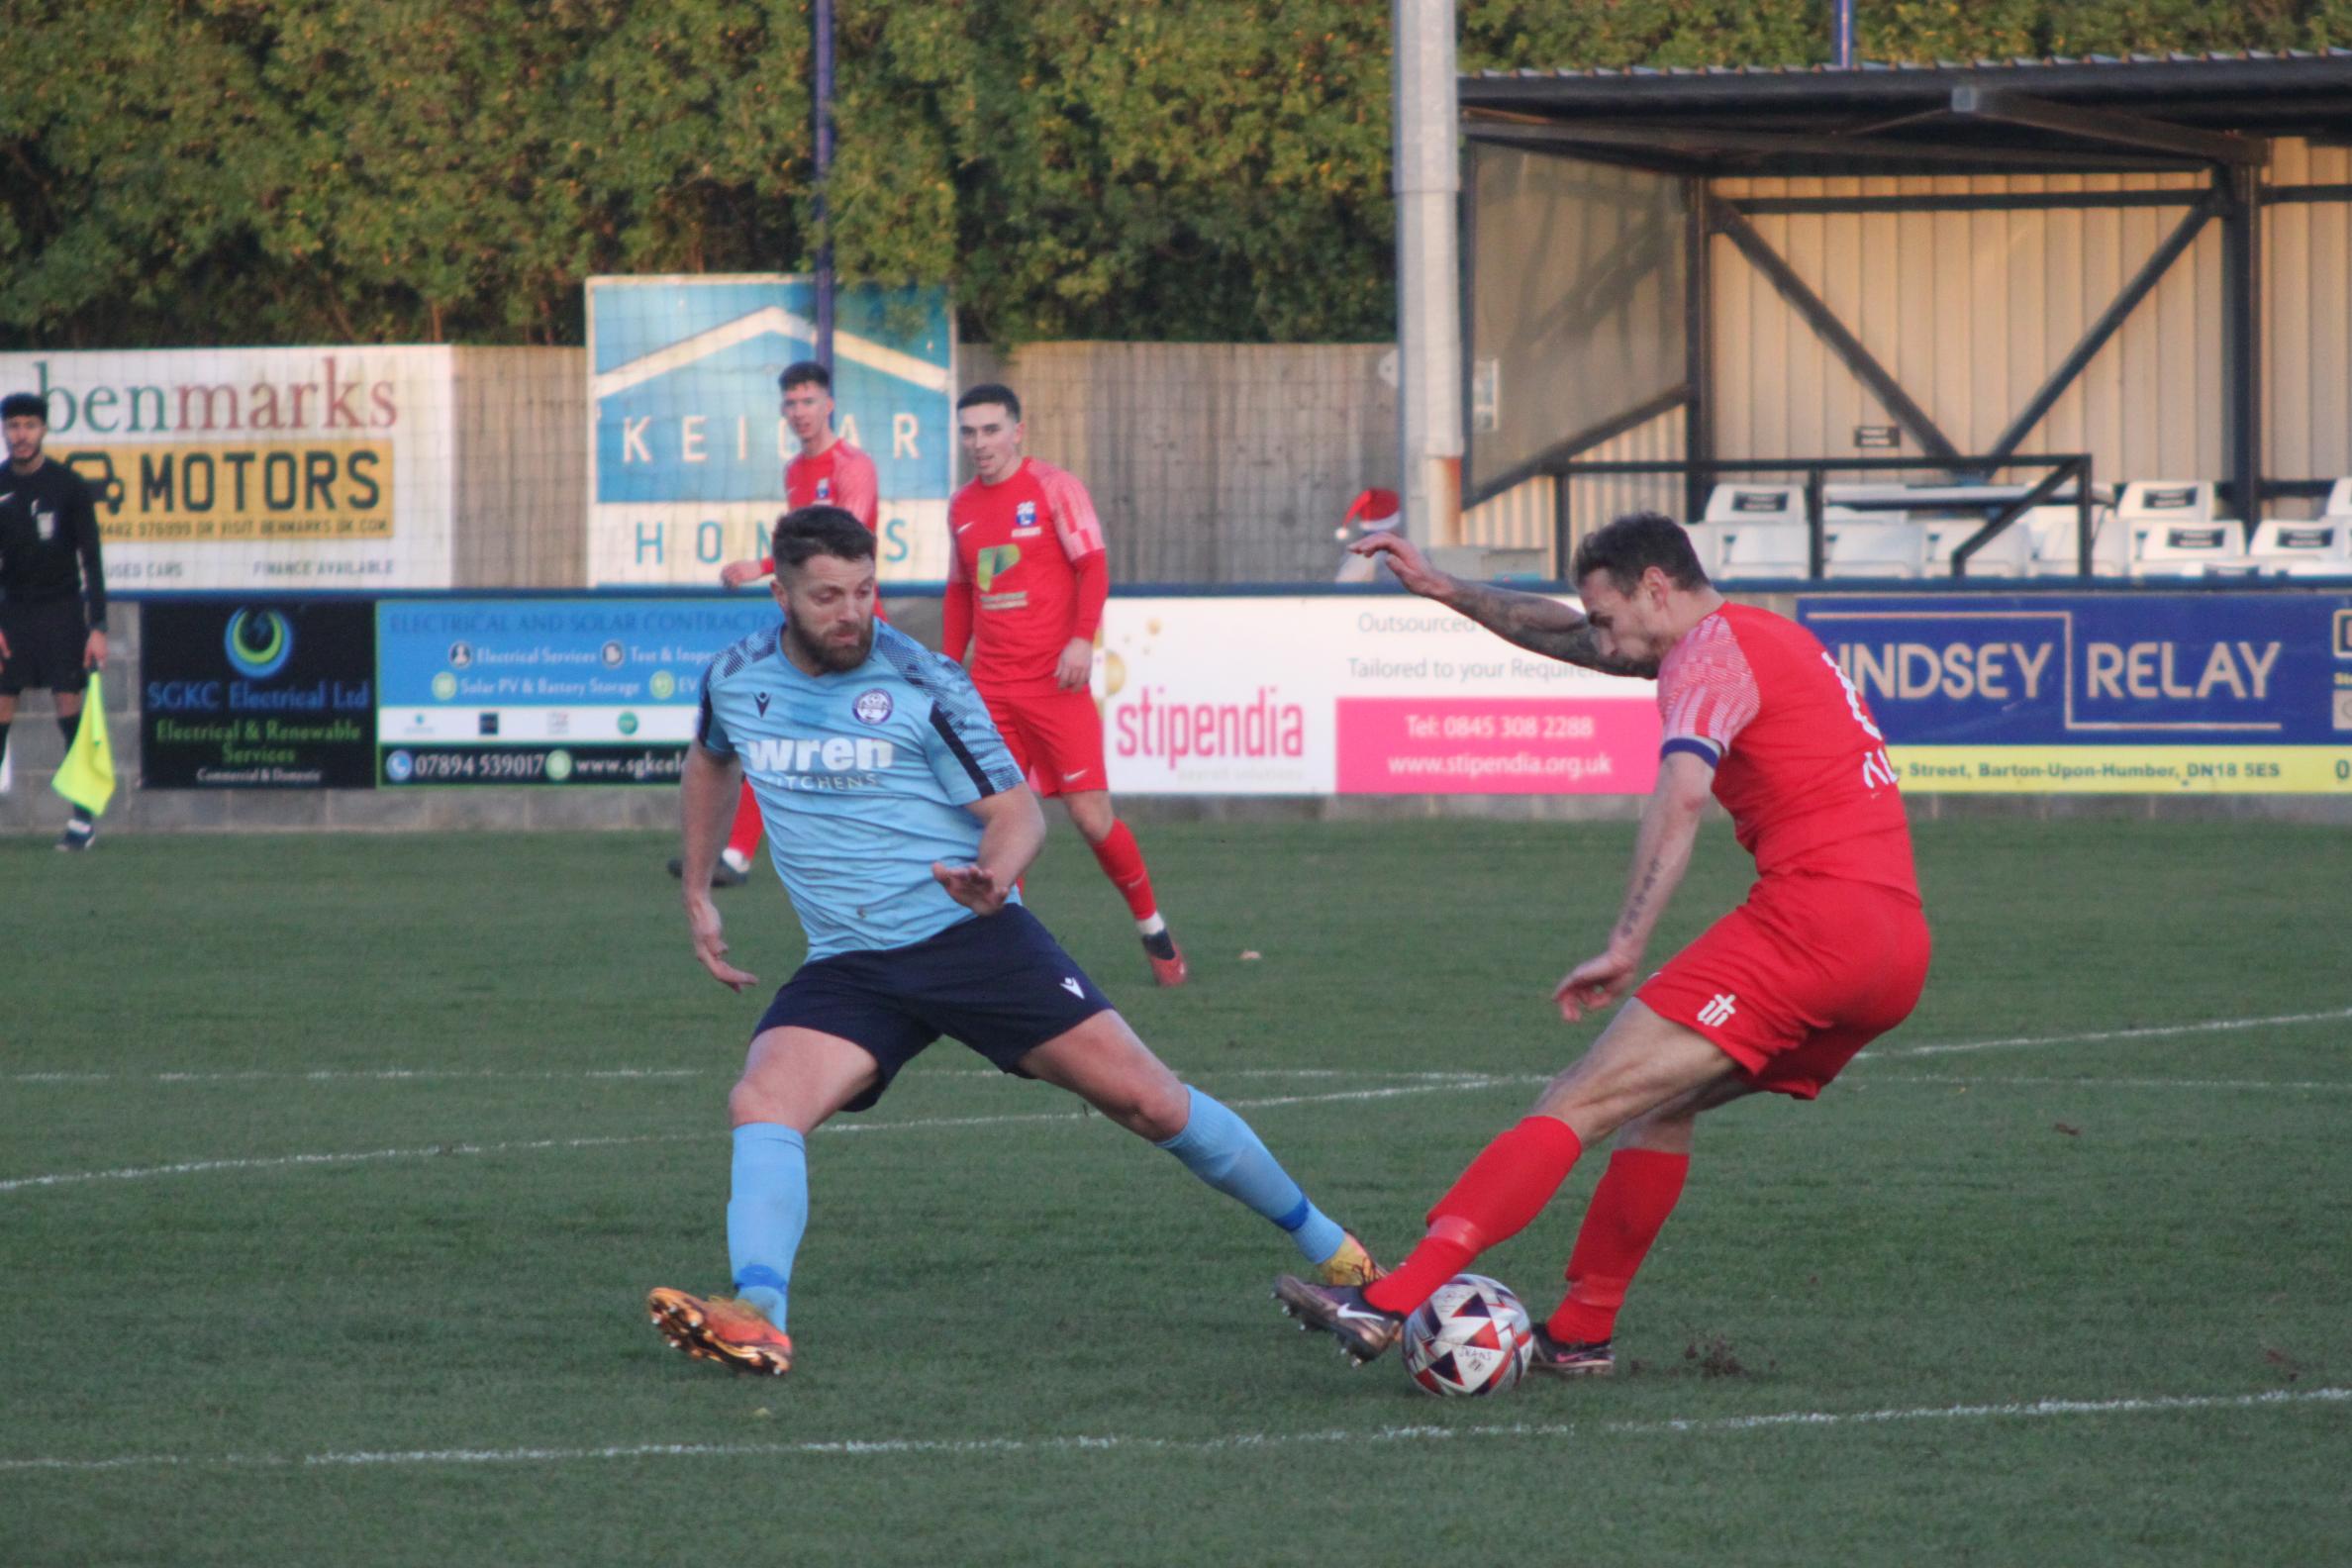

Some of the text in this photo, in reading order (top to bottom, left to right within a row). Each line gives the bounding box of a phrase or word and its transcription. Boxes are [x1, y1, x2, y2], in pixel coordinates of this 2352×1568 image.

[34, 356, 398, 434] benmarks
[141, 450, 380, 513] MOTORS
[636, 518, 909, 565] HOS
[147, 561, 182, 578] CARS
[252, 559, 394, 577] FINANCE AVAILABLE
[389, 610, 782, 634] ELECTRICAL AND SOLAR CONTRACTO
[1357, 612, 1477, 635] Outsourced
[477, 646, 539, 664] Electrical
[541, 646, 597, 664] Services
[1347, 657, 1427, 679] Tailored
[1433, 660, 1455, 679] to
[1458, 662, 1505, 683] your
[1839, 641, 2053, 700] INDSEY
[2087, 641, 2281, 700] RELAY
[147, 681, 369, 709] SGKC Electrical Ltd
[460, 677, 495, 695] Solar
[499, 677, 519, 694] PV
[538, 677, 587, 698] Battery
[589, 677, 640, 698] Storage
[156, 719, 240, 740] Electrical
[266, 719, 361, 740] Renewable
[1117, 685, 1304, 770] stipendia
[1443, 715, 1495, 738] 0845
[222, 743, 295, 763] Services
[415, 750, 683, 779] 07894 539017 www.sgkcel
[748, 737, 894, 771] wren
[1388, 753, 1613, 781] www.stipendia.org.uk
[2186, 761, 2237, 777] DN18
[2245, 761, 2281, 777] 5ES
[764, 774, 877, 790] ITCHENS
